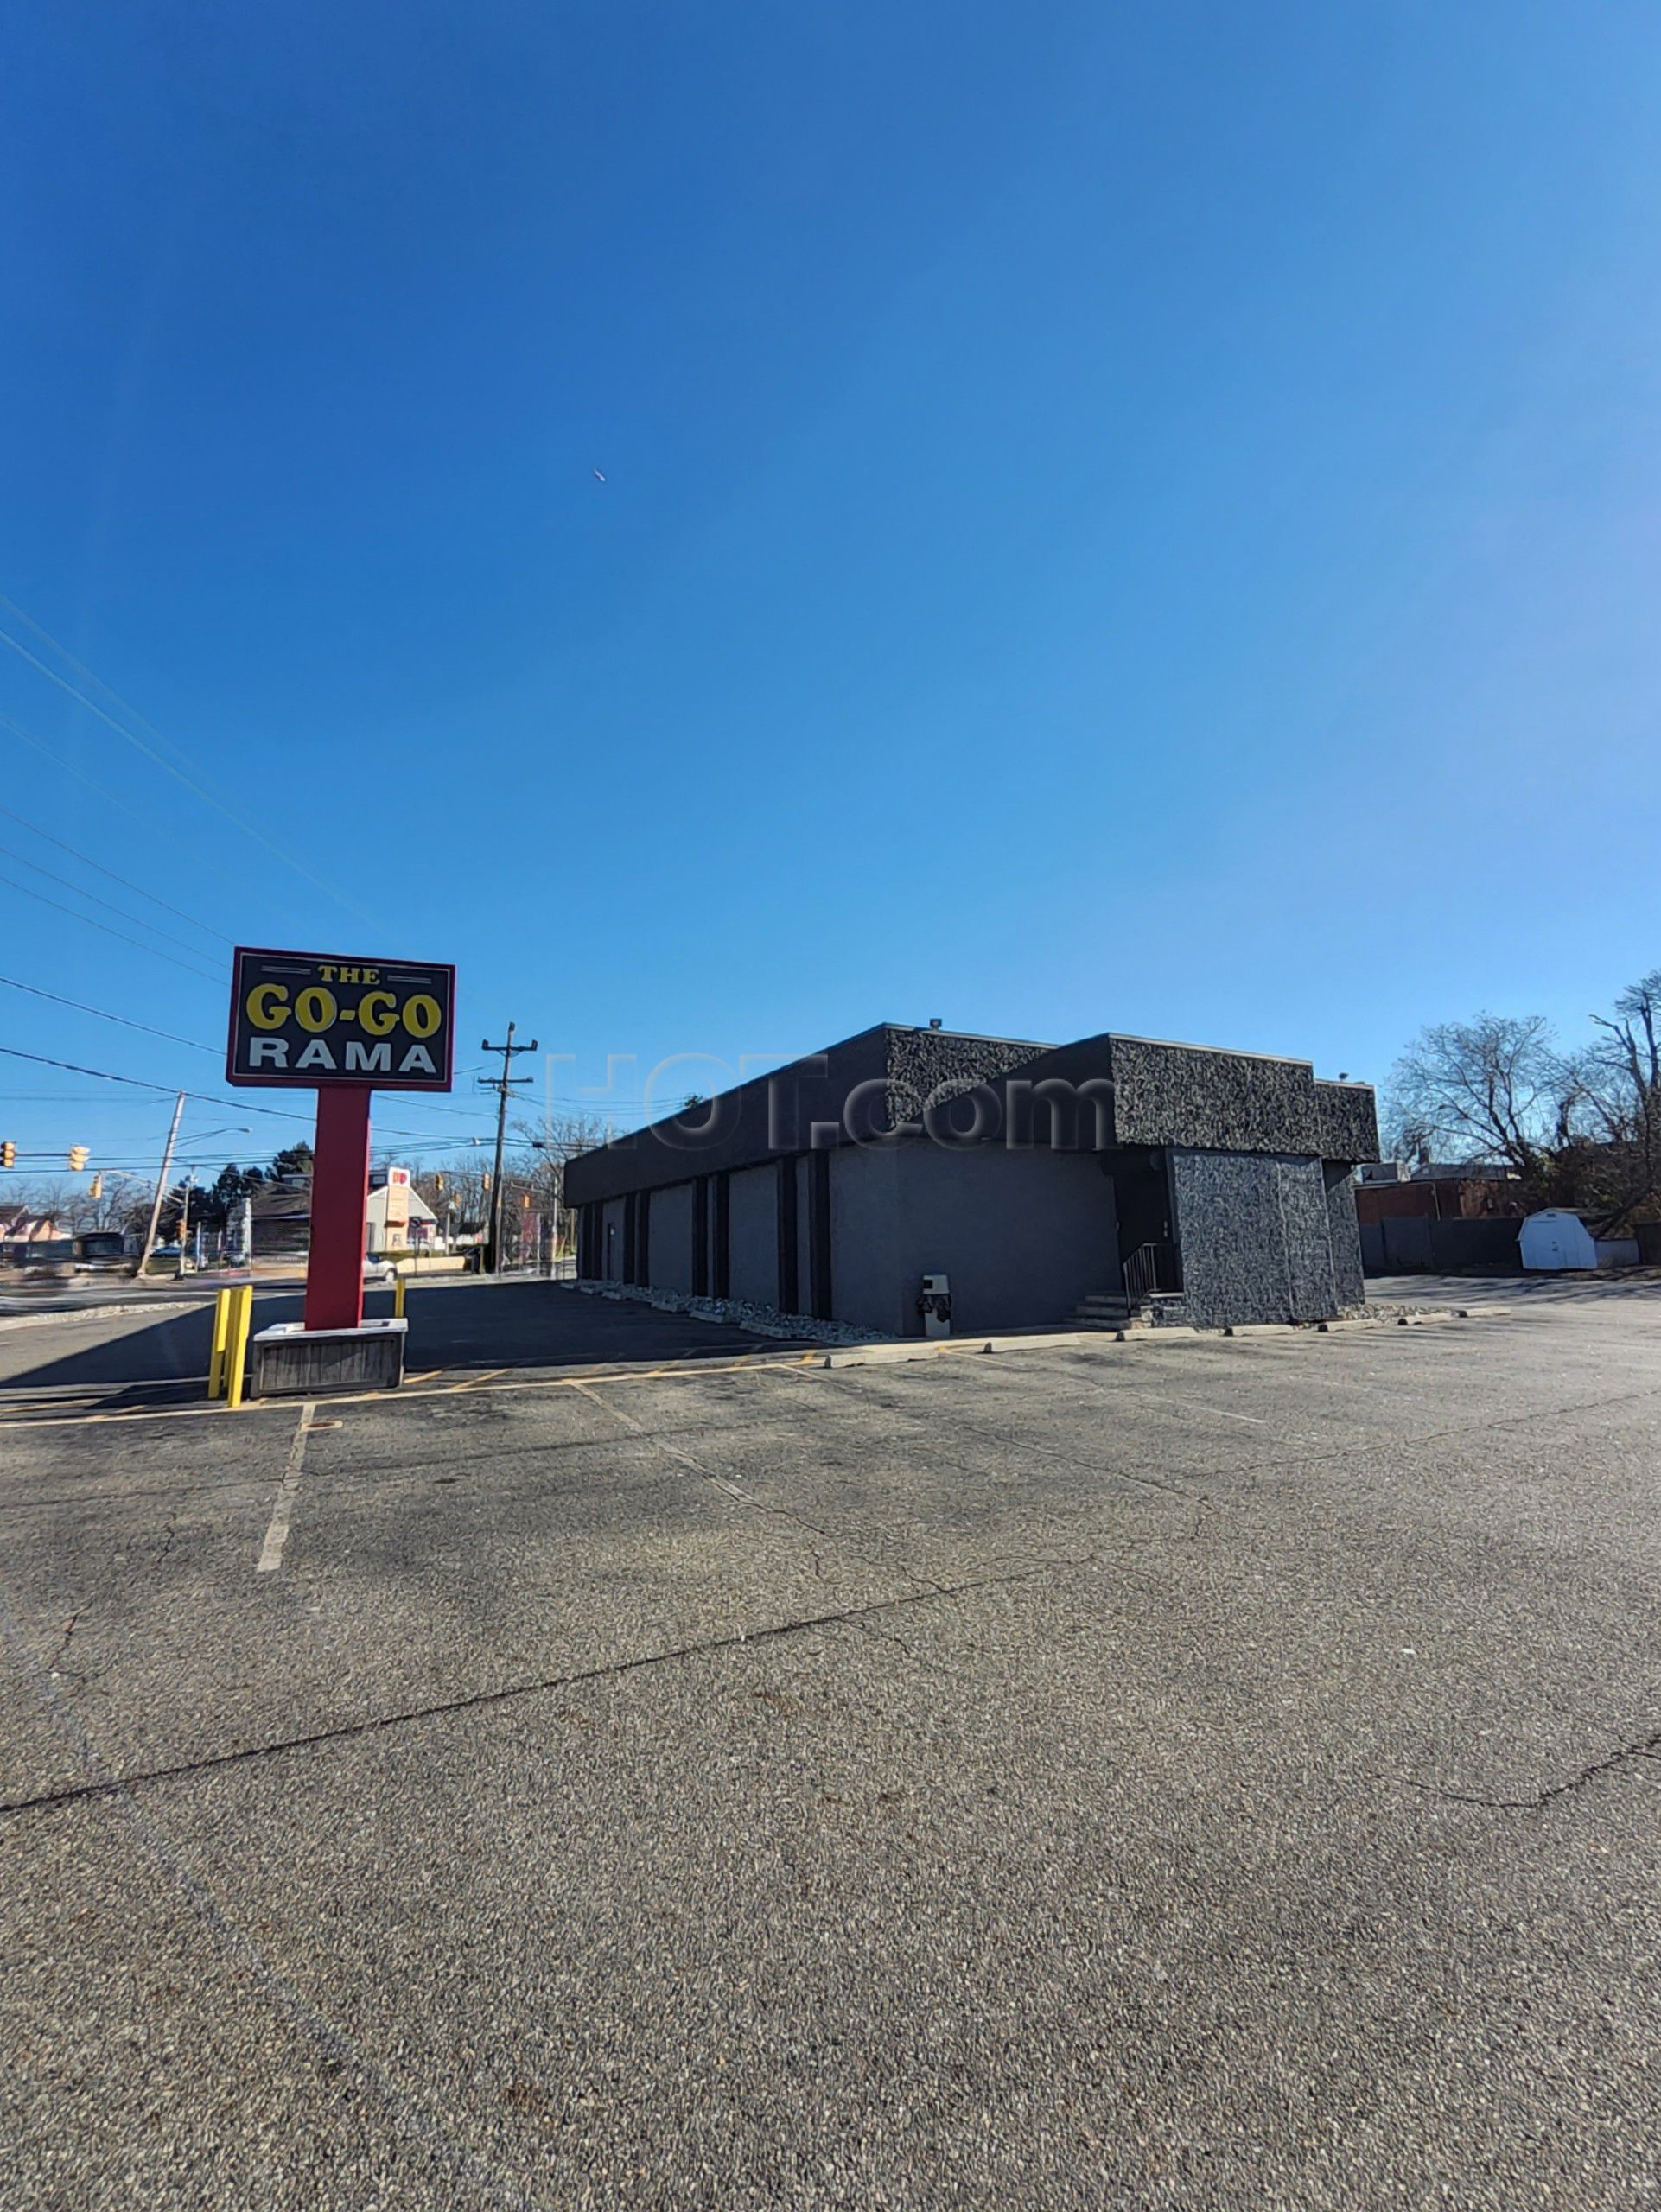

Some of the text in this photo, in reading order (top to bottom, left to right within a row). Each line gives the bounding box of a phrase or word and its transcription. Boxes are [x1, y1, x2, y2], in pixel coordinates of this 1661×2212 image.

[317, 965, 380, 984] THE
[246, 983, 442, 1038] GO-GO
[249, 1037, 437, 1073] RAMA
